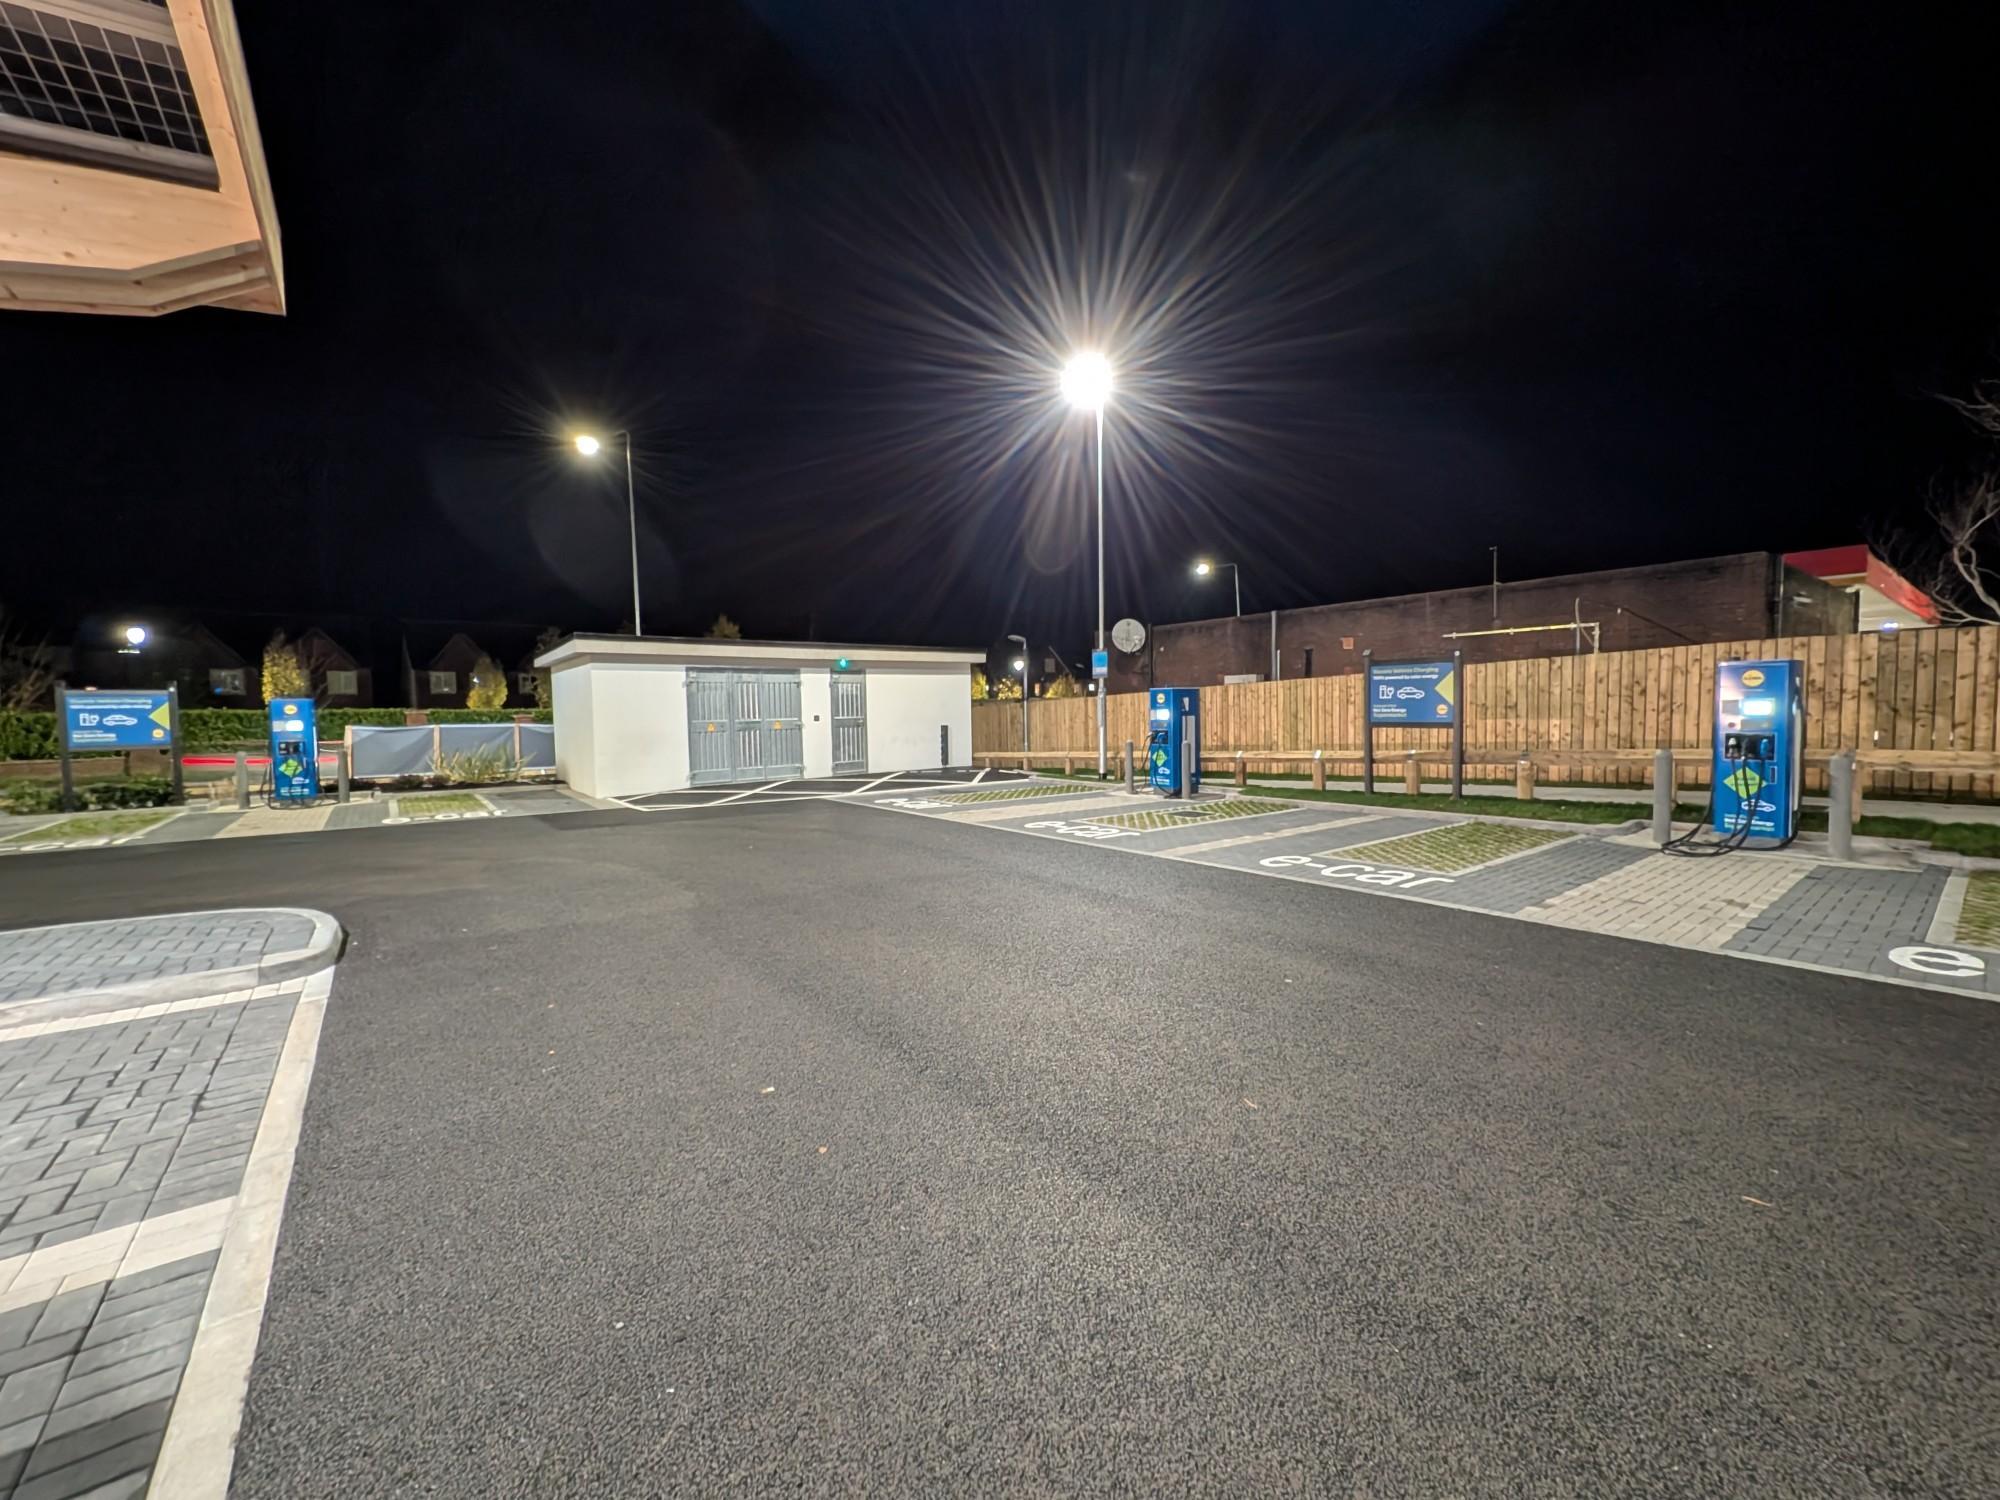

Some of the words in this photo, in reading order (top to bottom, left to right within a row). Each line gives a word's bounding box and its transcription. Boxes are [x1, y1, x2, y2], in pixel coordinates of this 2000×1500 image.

[1023, 821, 1141, 840] e-car
[1259, 855, 1456, 889] e-car
[1888, 946, 1985, 977] e
